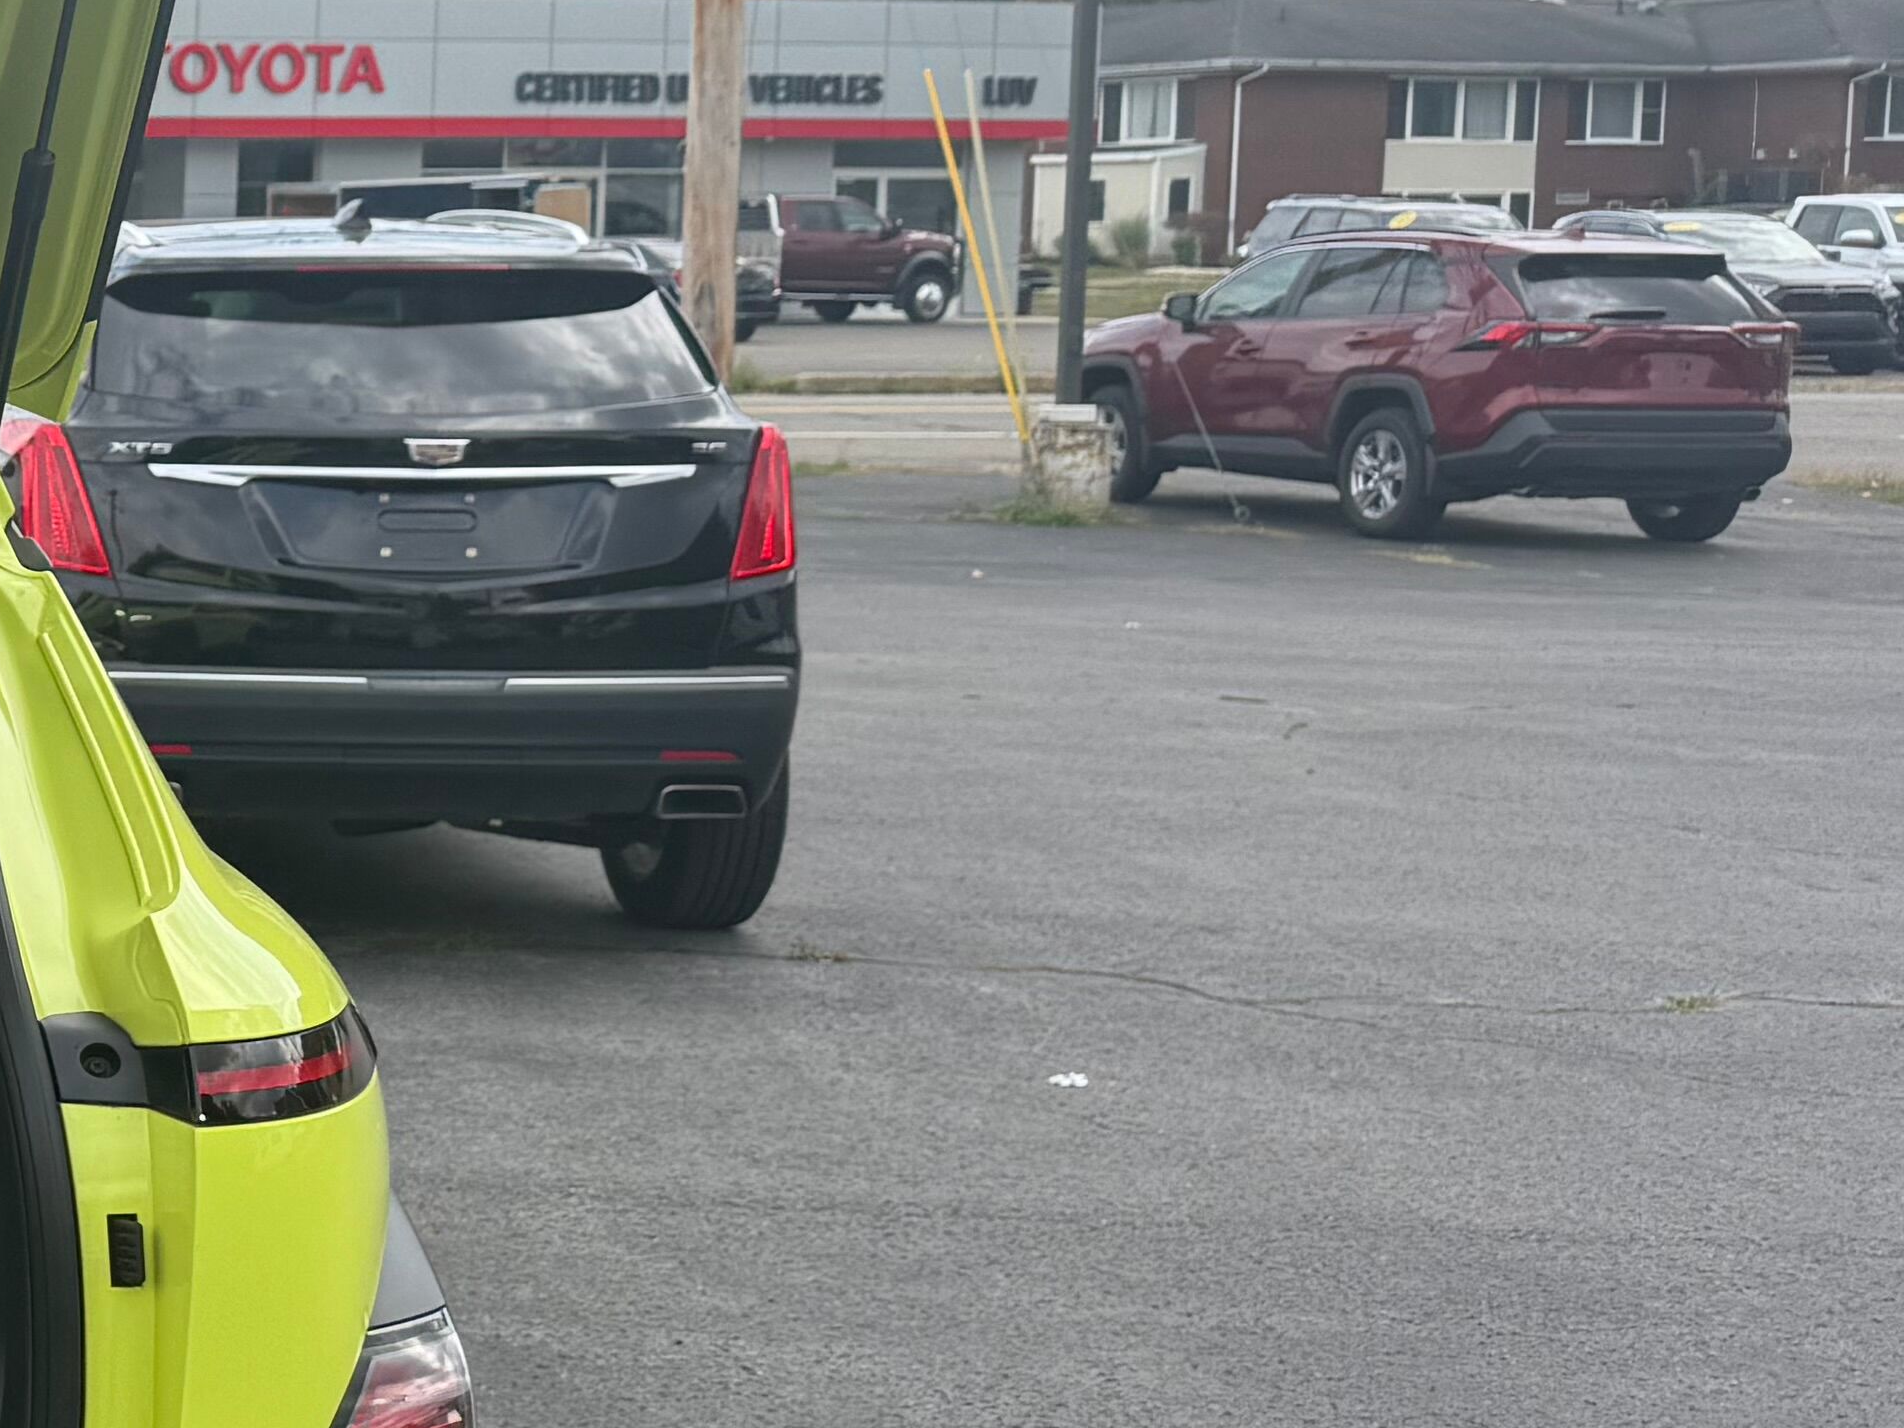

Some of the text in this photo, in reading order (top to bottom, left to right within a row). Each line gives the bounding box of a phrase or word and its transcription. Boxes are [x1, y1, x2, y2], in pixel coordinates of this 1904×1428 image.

[164, 42, 386, 95] OYOTA
[515, 73, 661, 104] CERTIFIED
[748, 74, 884, 104] VEHICLES
[983, 75, 1038, 107] LUV
